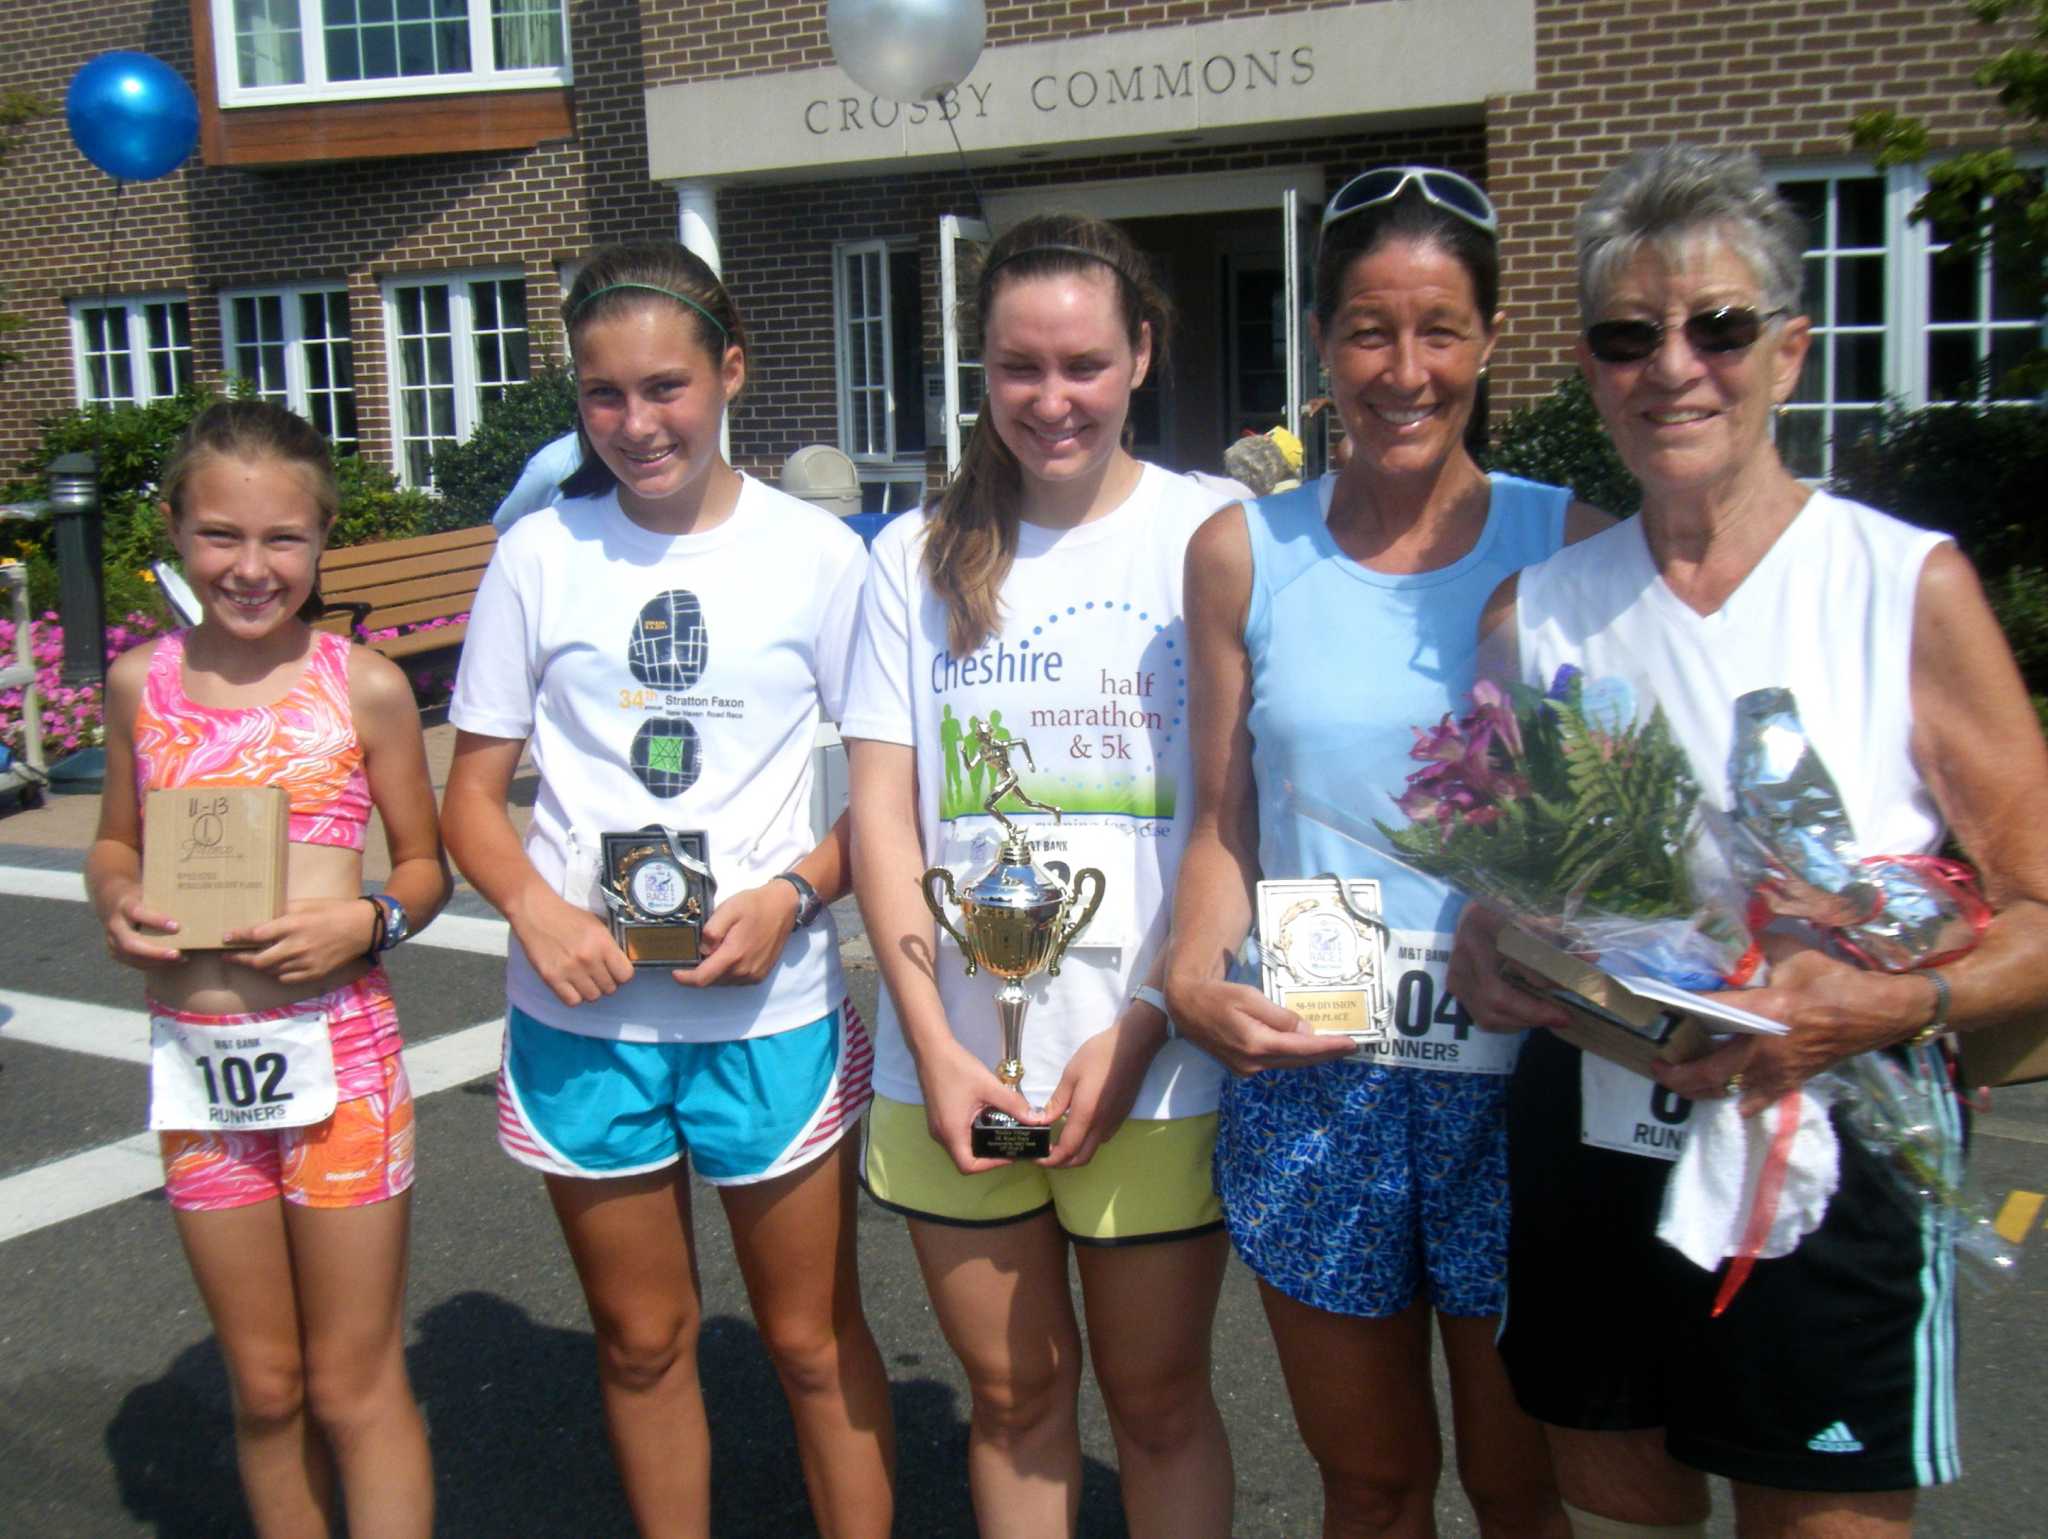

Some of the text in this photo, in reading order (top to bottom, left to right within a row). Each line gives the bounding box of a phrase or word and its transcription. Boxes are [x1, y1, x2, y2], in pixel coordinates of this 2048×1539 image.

[803, 46, 1316, 135] CROSBY COMMONS
[931, 643, 1063, 694] Cheshire
[1100, 668, 1155, 697] half
[665, 694, 708, 706] Stratton
[711, 696, 745, 708] Faxon
[1030, 701, 1163, 730] marathon
[1069, 734, 1132, 760] & 5k
[1044, 840, 1068, 852] BANK
[1398, 947, 1450, 963] M&T BAN
[1317, 1000, 1357, 1010] DIVISION
[1322, 1012, 1349, 1022] PLACE
[1364, 1039, 1460, 1062] RUNNERS
[195, 1052, 293, 1108] 102
[209, 1103, 286, 1123] RUNNERS
